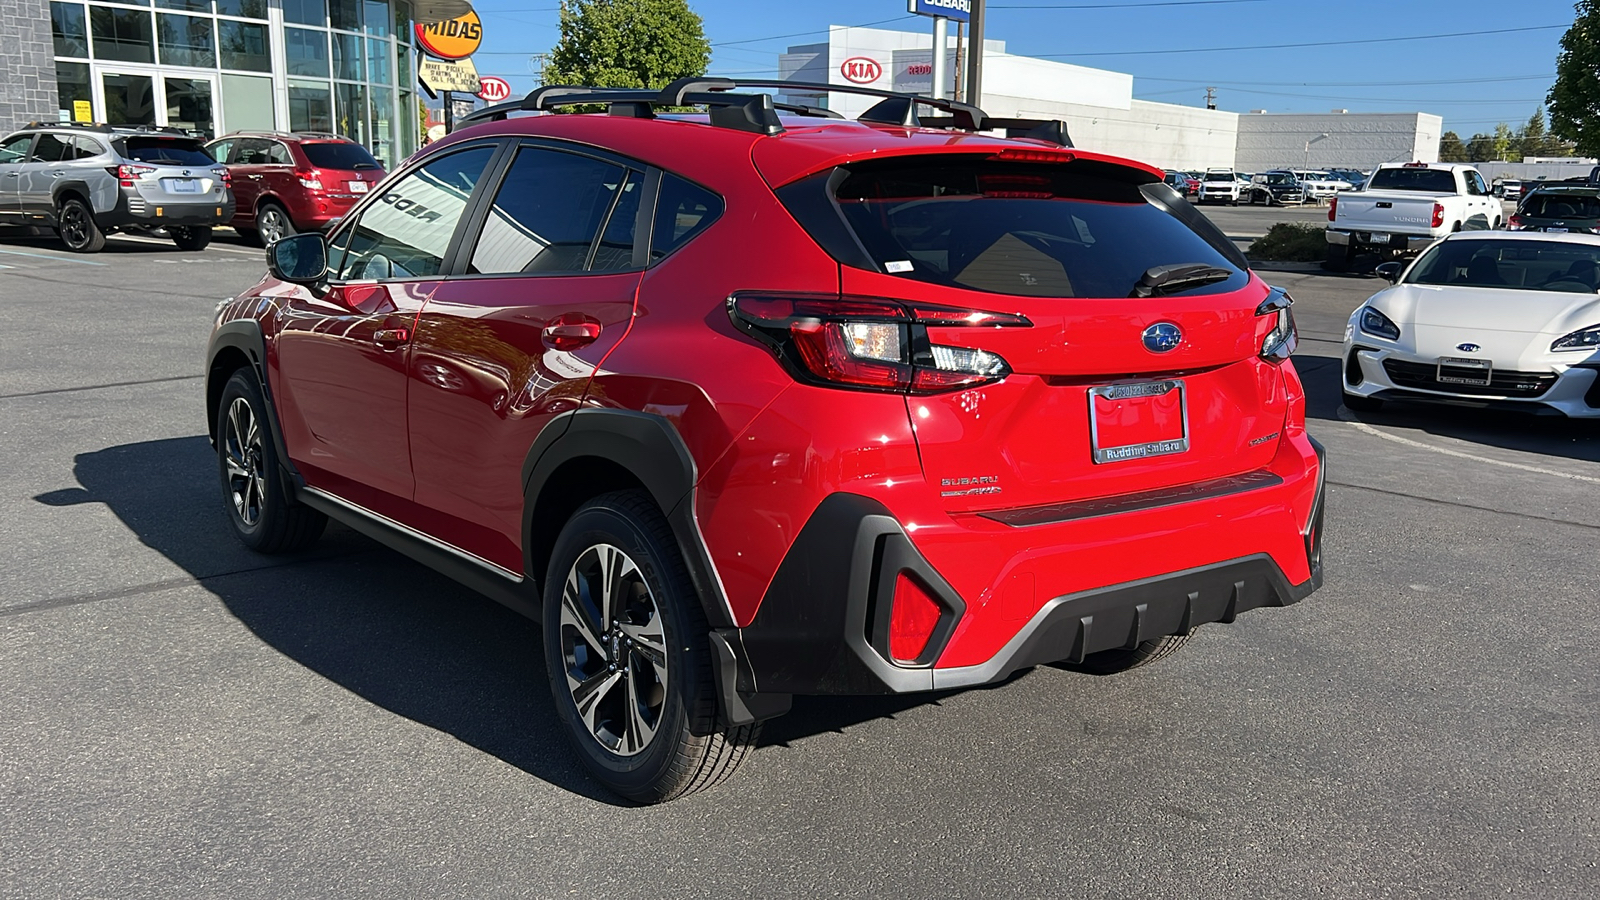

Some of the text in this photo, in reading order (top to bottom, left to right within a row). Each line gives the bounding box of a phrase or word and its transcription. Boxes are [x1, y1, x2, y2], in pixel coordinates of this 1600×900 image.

[423, 20, 481, 40] MIDAS
[847, 62, 875, 79] KIA
[481, 82, 505, 98] KIA
[1393, 216, 1429, 224] TUNDRA
[1147, 442, 1180, 453] Subaru
[941, 475, 998, 487] SUBARU
